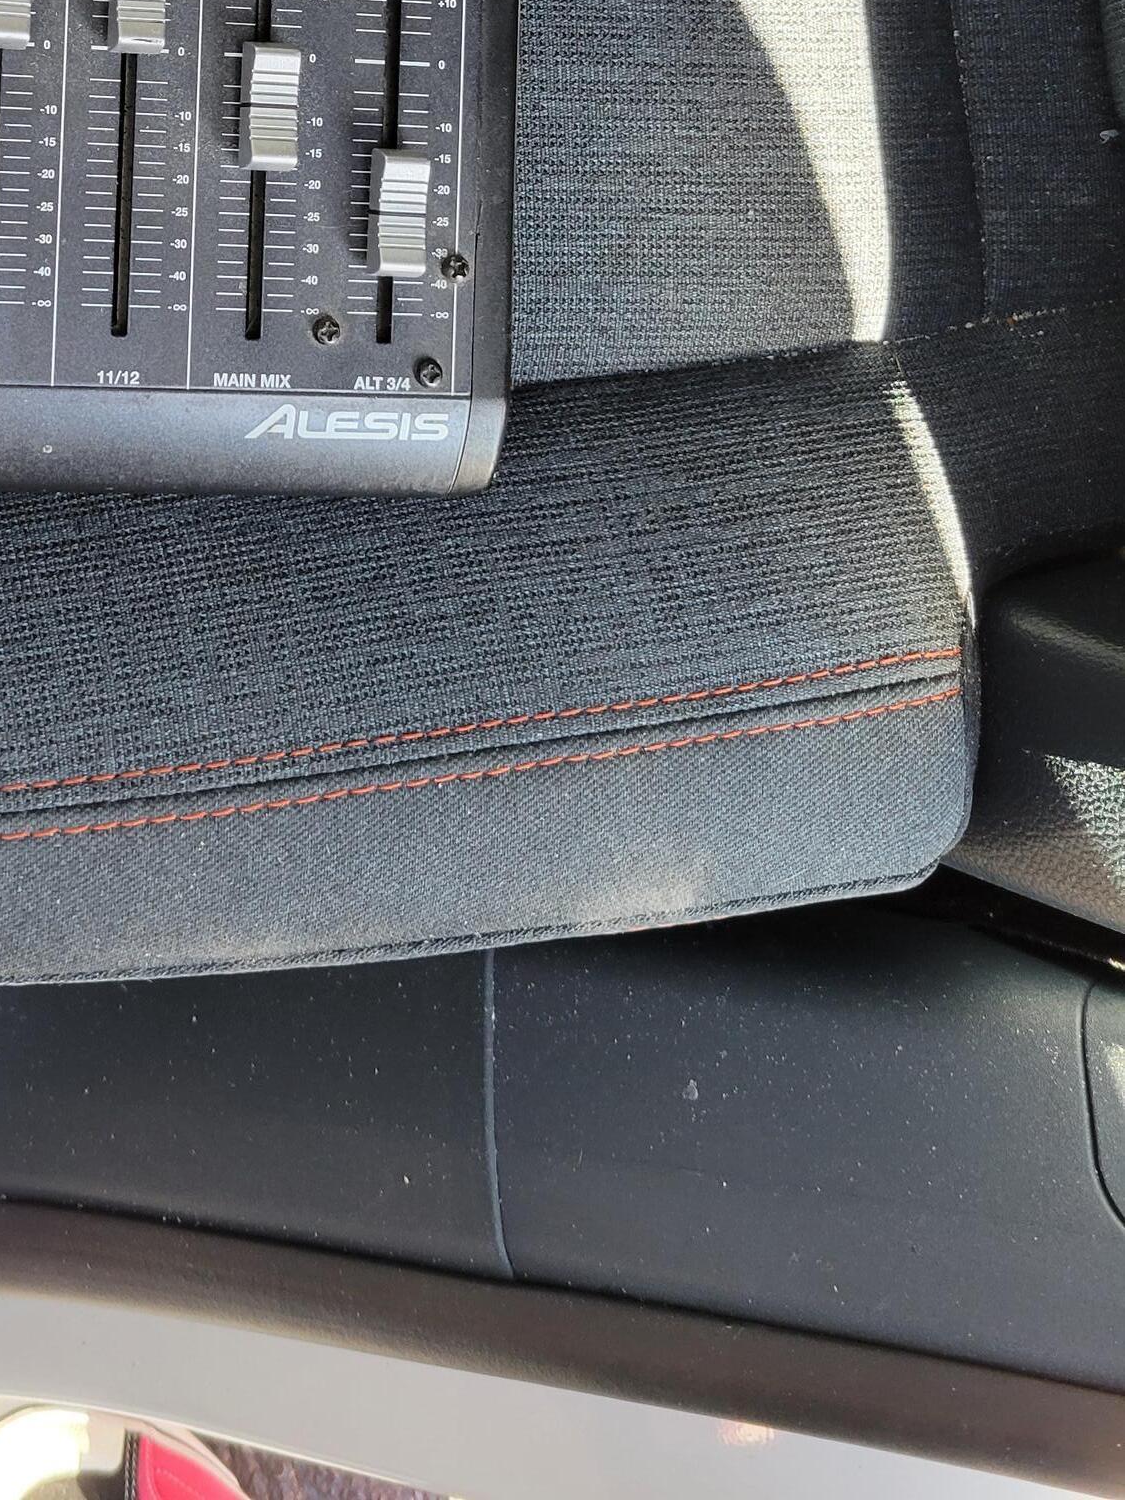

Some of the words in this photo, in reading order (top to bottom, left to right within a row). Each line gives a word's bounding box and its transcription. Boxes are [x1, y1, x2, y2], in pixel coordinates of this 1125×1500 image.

[307, 117, 322, 126] -10
[97, 370, 140, 386] 11/12
[213, 373, 255, 389] MAIN
[259, 374, 291, 389] MIX
[354, 377, 383, 391] ALT
[385, 377, 410, 392] 3/4
[245, 404, 448, 441] ALESIS
